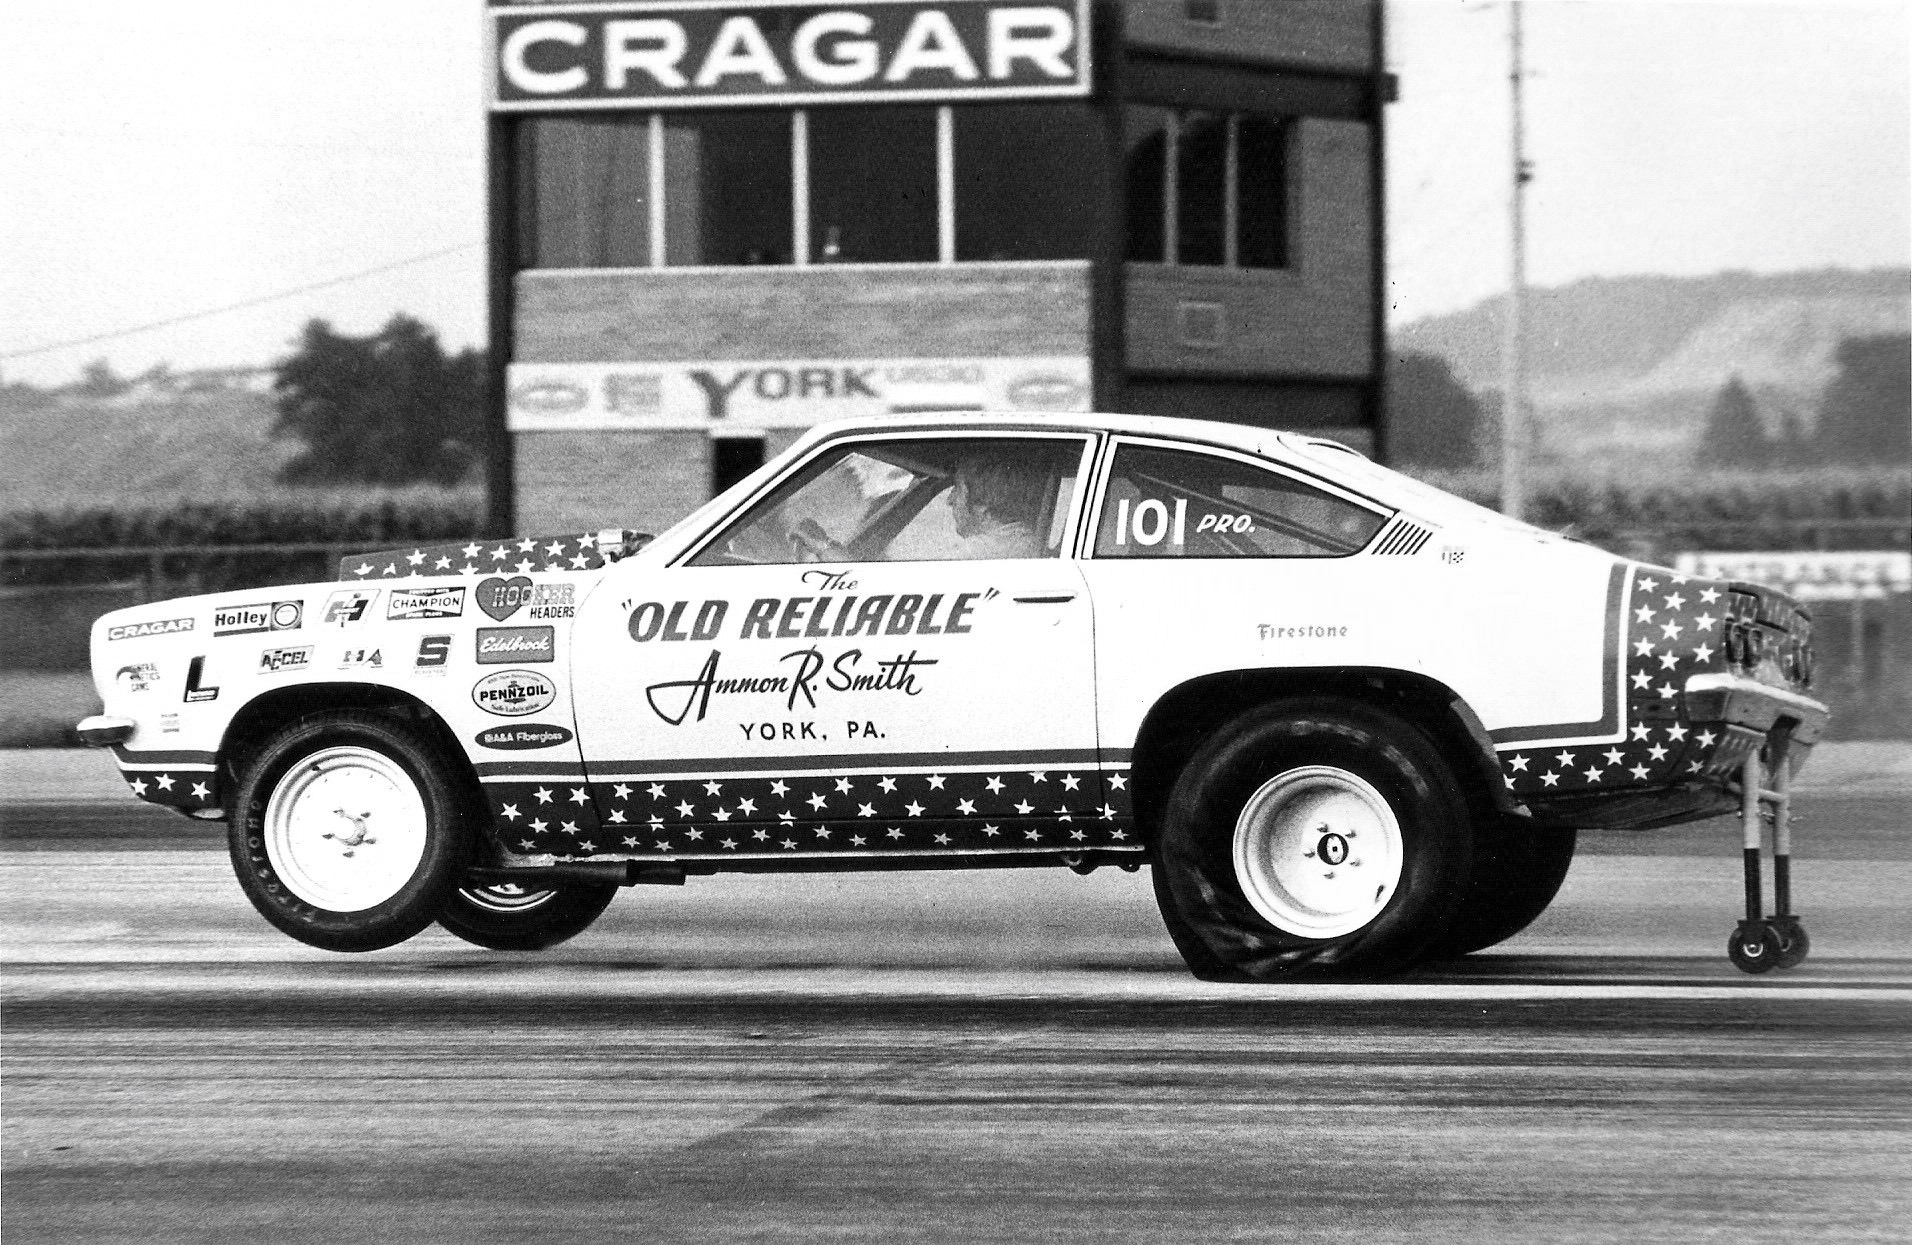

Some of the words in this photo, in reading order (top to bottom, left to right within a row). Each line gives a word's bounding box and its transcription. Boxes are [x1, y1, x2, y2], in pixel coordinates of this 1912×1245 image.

[502, 6, 1075, 94] CRAGAR
[685, 366, 882, 420] YORK
[1115, 498, 1188, 546] 101
[1196, 514, 1256, 533] PRO.
[800, 570, 858, 591] The
[392, 597, 460, 609] CHAMPION
[530, 606, 576, 619] HEADERS
[215, 611, 267, 627] Holley
[109, 618, 194, 640] CRAGAR
[1257, 623, 1348, 640] Firestone
[480, 635, 550, 653] Edelbrock
[480, 685, 549, 702] PENNZOIL
[646, 648, 788, 726] Ammon
[780, 644, 825, 711] R.
[826, 649, 938, 696] Smith
[516, 731, 563, 743] Fiberglass
[740, 721, 828, 741] YORK,
[847, 720, 886, 740] PA.
